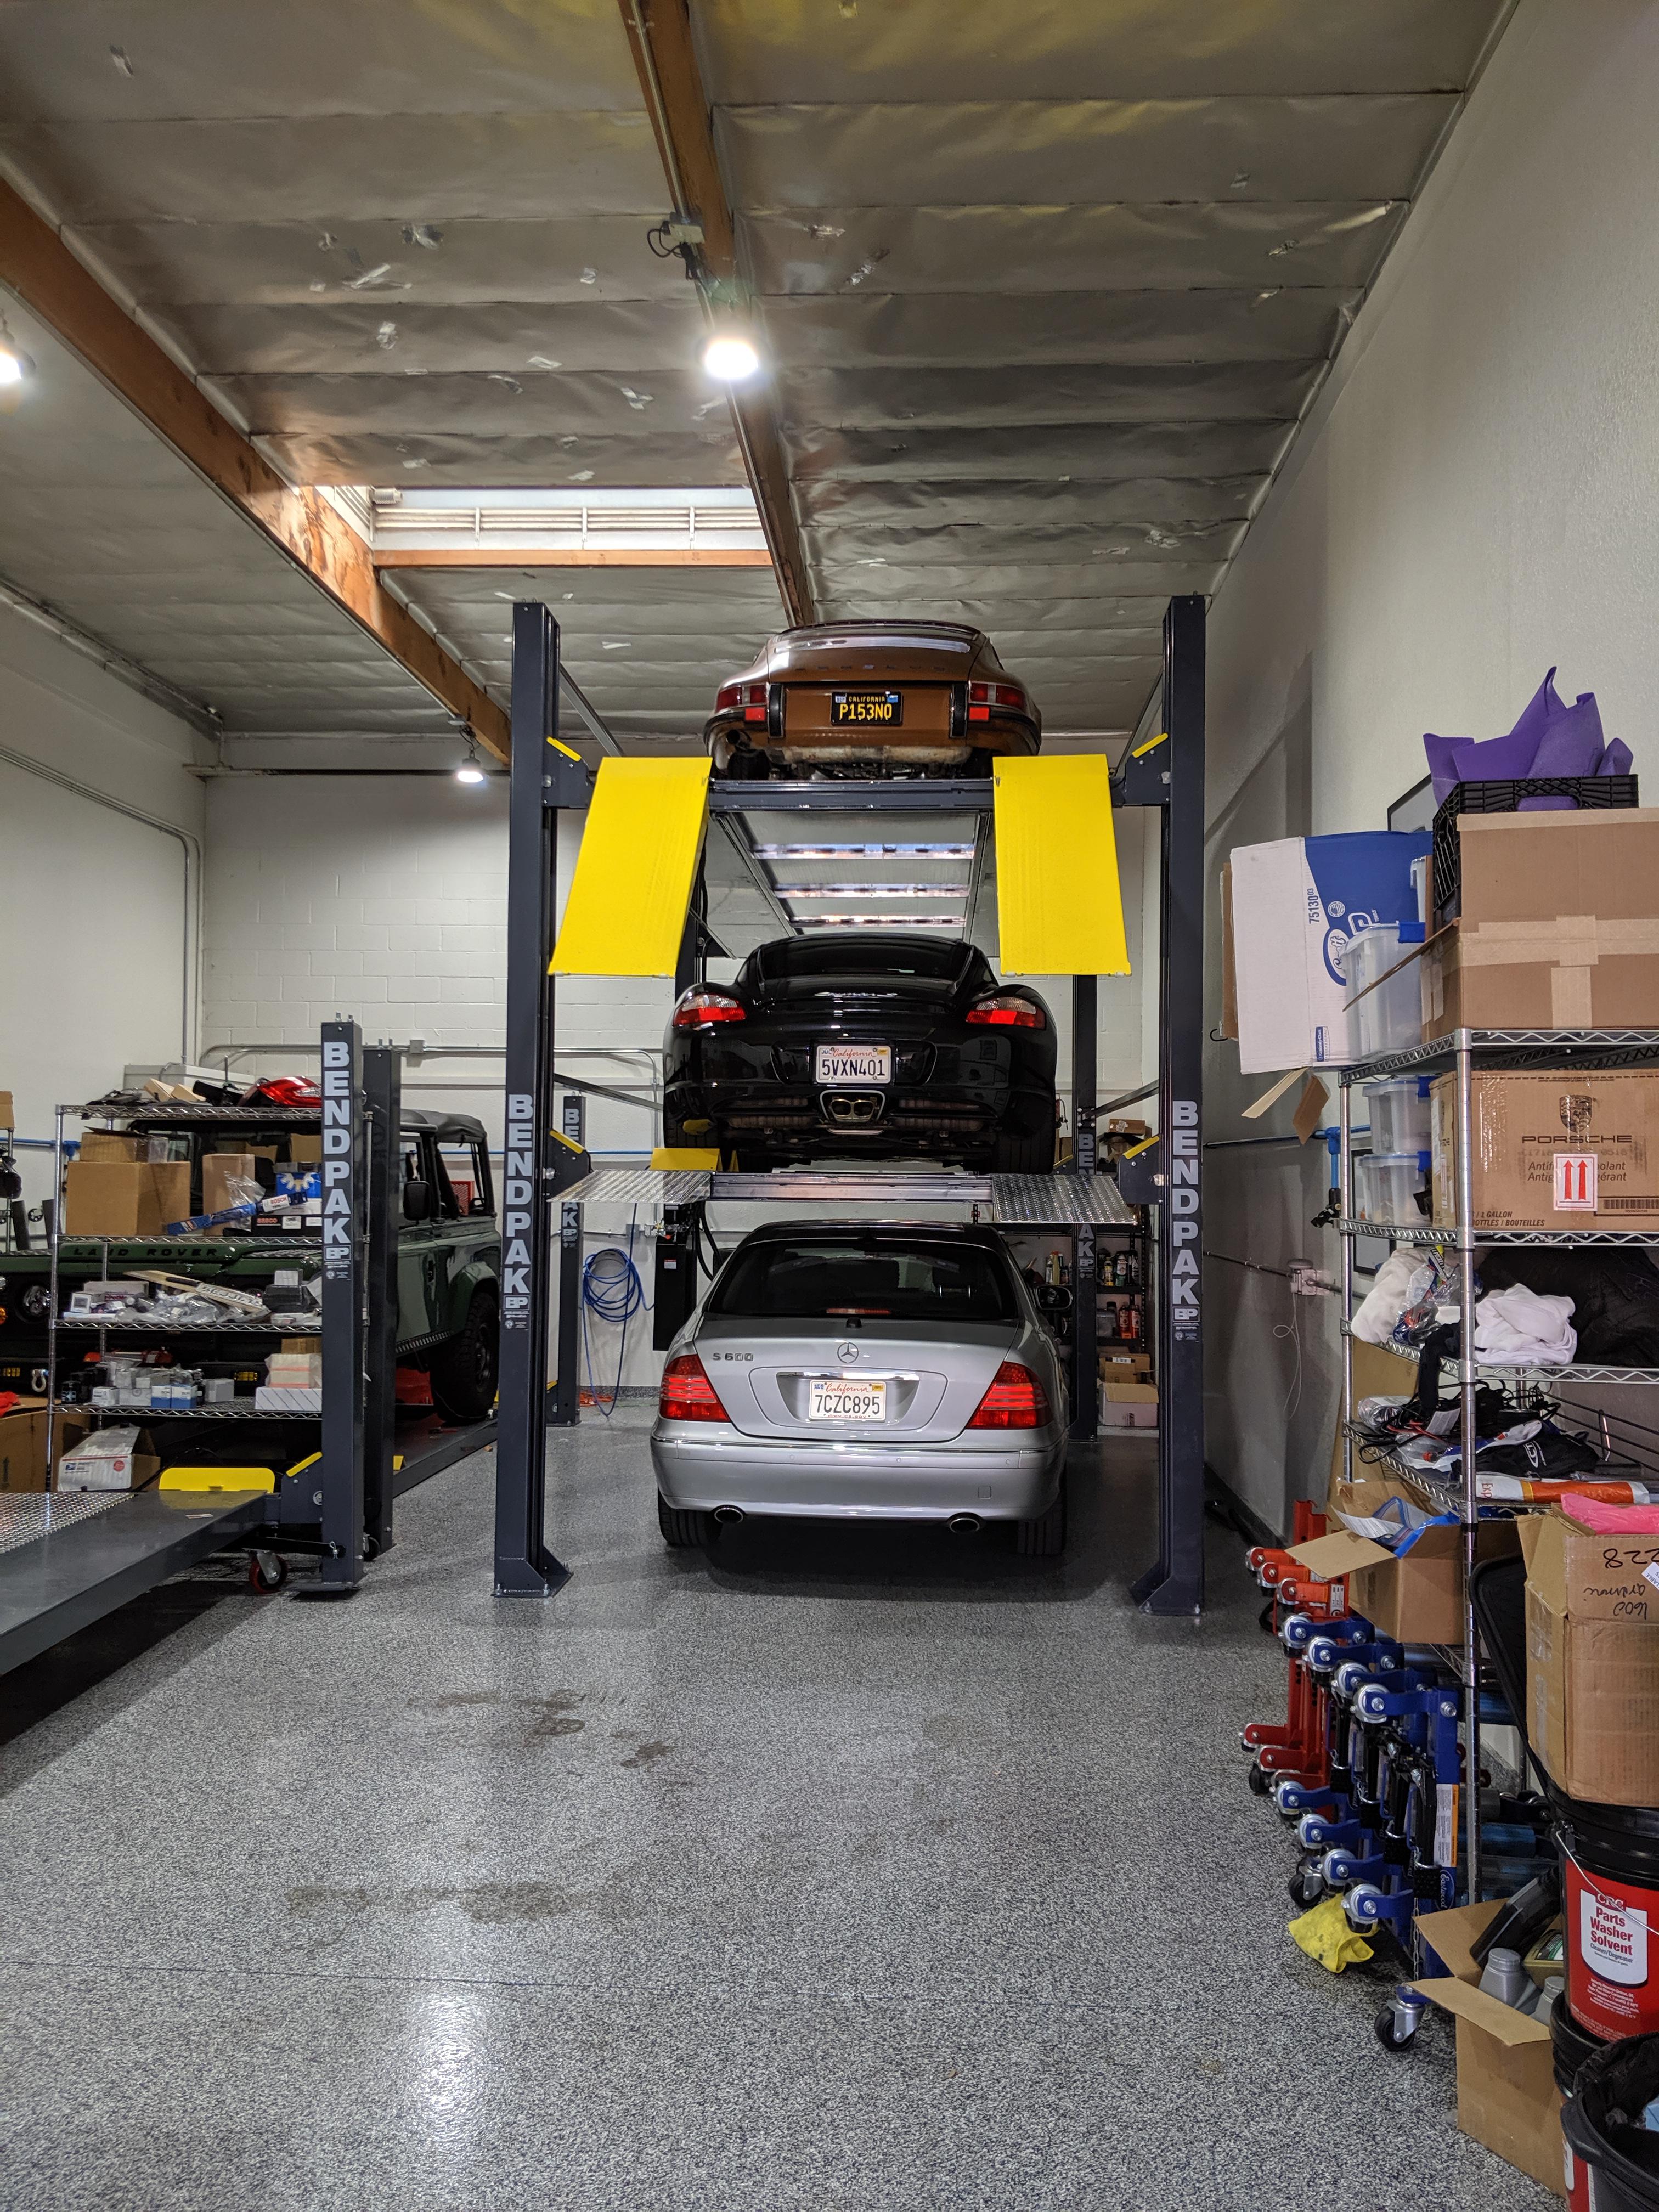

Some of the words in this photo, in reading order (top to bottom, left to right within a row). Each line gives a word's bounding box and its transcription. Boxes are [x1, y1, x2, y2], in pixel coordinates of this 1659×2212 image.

[833, 1048, 876, 1059] California
[822, 1059, 885, 1076] 5VXN401
[324, 1042, 351, 1244] BENDPAK
[1522, 1135, 1633, 1144] PORSCHE
[504, 1094, 533, 1294] BENDPAK
[1172, 1101, 1200, 1305] BENDPAK
[146, 1248, 218, 1256] ROVER
[713, 1352, 722, 1361] S
[725, 1353, 754, 1361] 600
[826, 1383, 872, 1395] California
[815, 1395, 880, 1415] 7CZC895
[1596, 1906, 1626, 1927] Parts
[1590, 1916, 1633, 1942] Washer
[1590, 1930, 1633, 1956] Solvent
